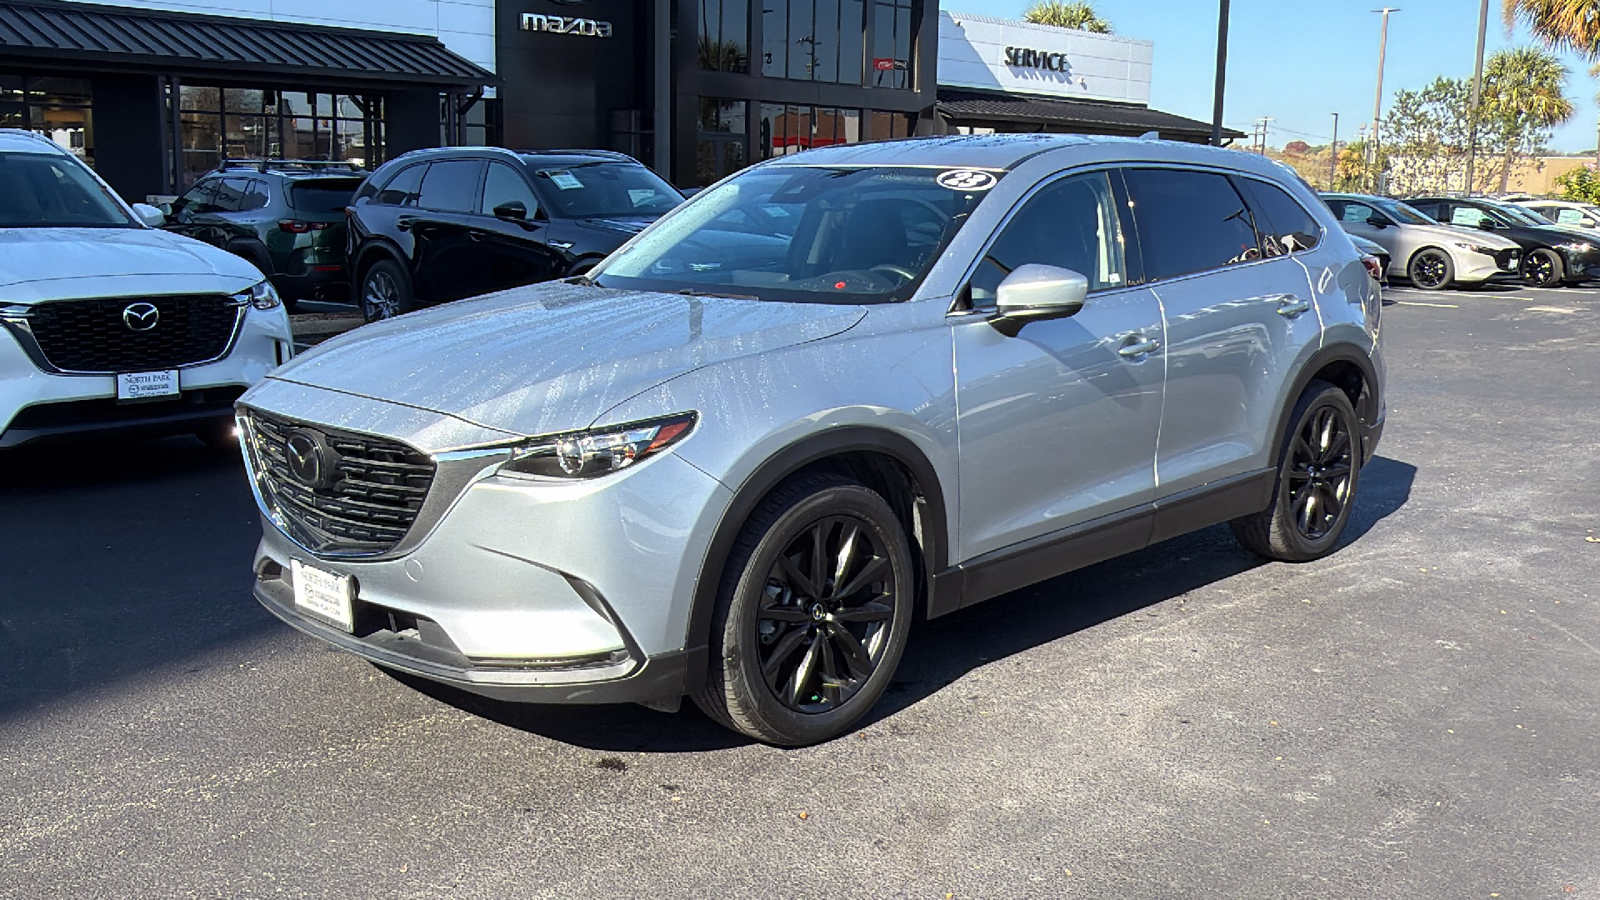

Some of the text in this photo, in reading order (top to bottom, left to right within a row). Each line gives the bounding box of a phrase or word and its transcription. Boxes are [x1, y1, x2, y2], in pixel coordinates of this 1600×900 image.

[1004, 46, 1067, 72] SERVICE
[125, 374, 171, 384] NORTH PARK
